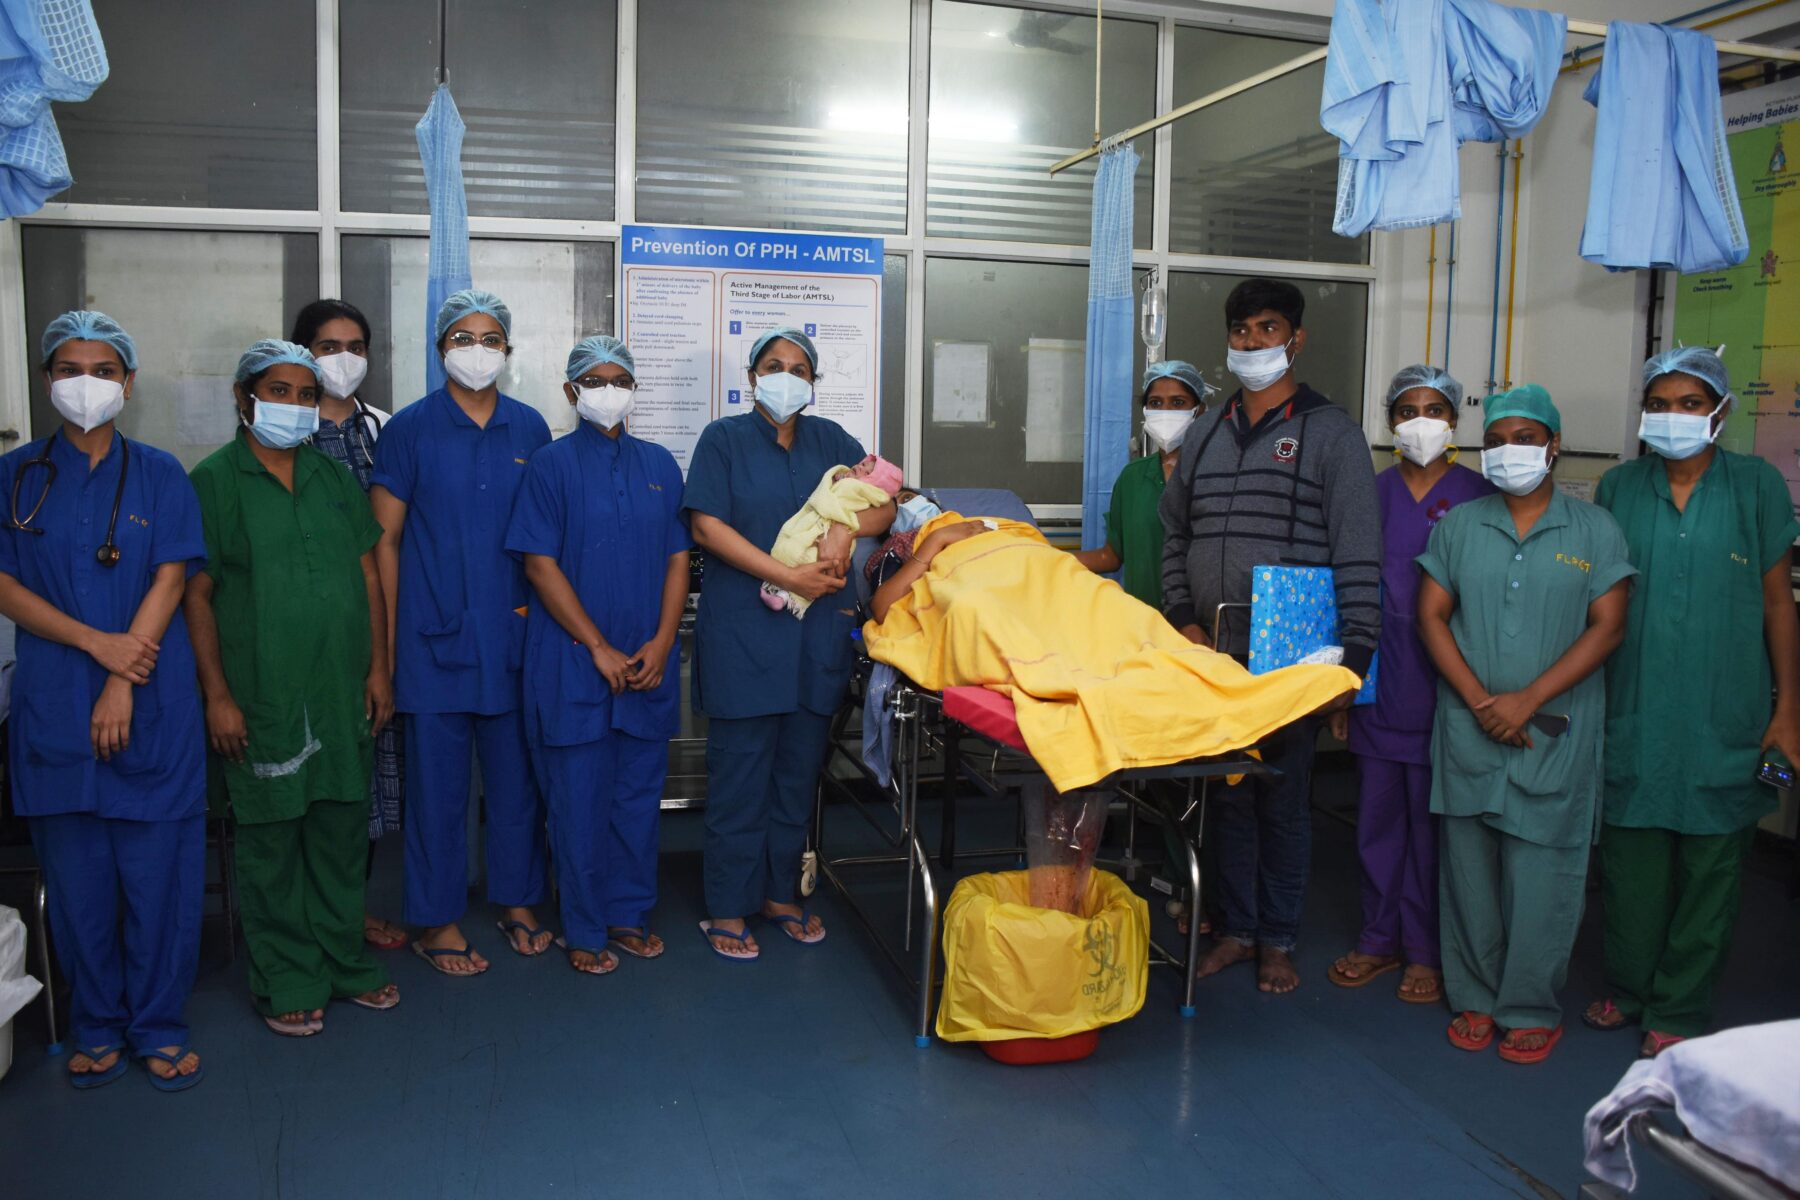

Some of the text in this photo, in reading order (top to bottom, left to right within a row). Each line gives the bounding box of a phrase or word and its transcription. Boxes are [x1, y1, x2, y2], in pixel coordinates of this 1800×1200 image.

[1727, 111, 1764, 127] Helping
[1765, 103, 1799, 119] Babies
[631, 237, 729, 257] Prevention
[734, 241, 756, 258] Of
[760, 243, 798, 260] PPH
[812, 246, 875, 264] AMTSL
[730, 281, 753, 289] Active
[754, 282, 799, 291] Management
[809, 284, 821, 292] the
[730, 290, 750, 298] Third
[751, 291, 771, 300] Stage
[802, 294, 835, 302] (AMTSL)
